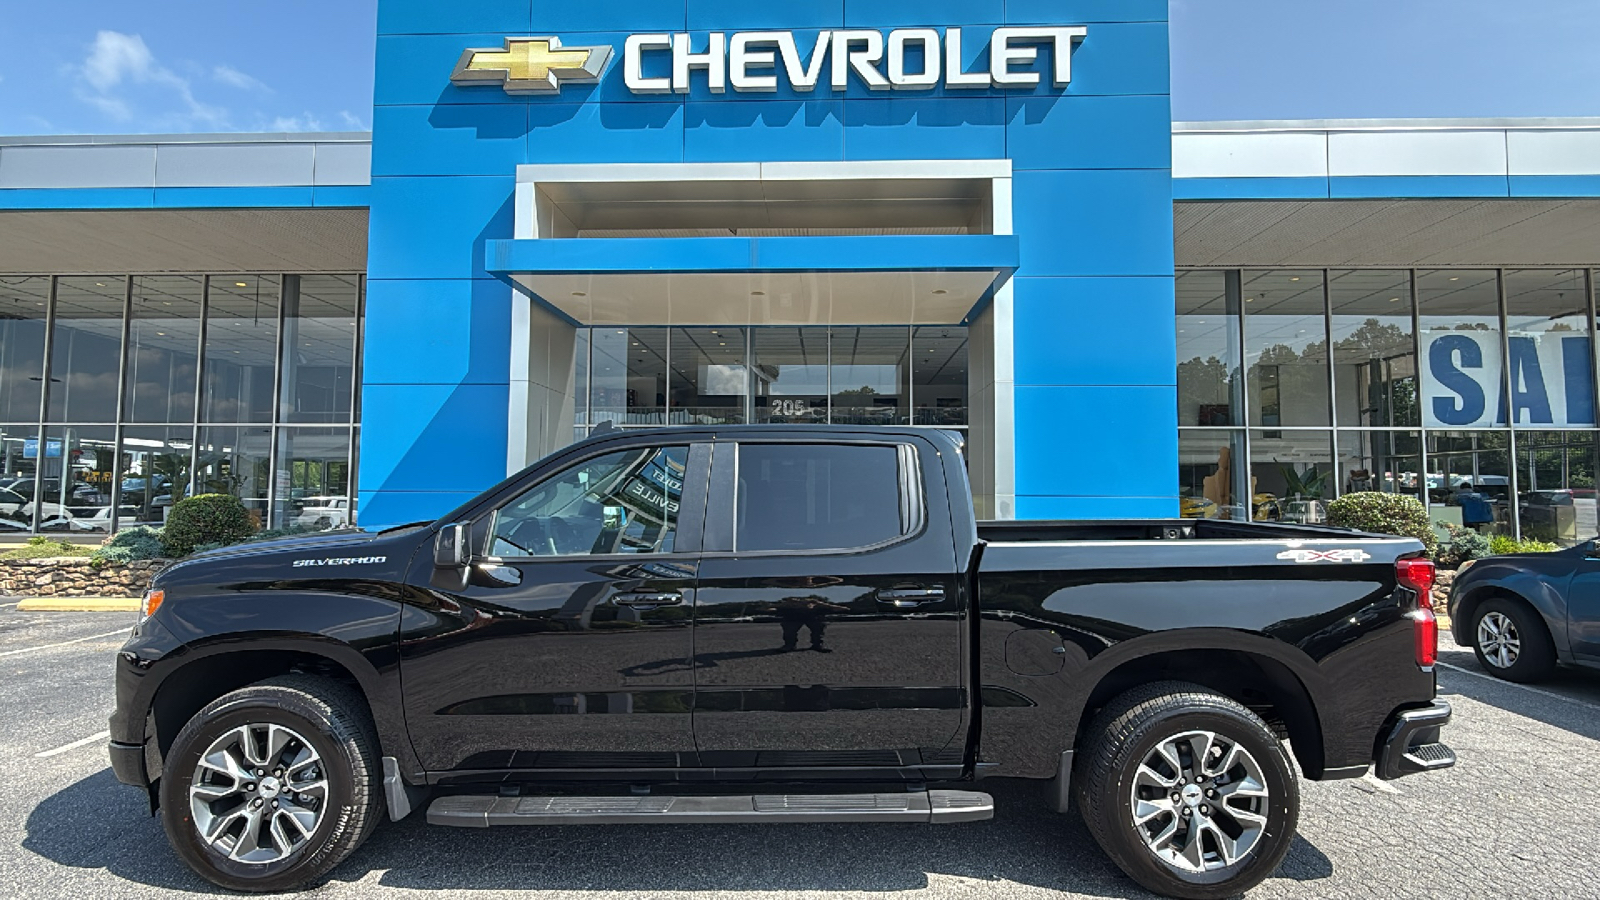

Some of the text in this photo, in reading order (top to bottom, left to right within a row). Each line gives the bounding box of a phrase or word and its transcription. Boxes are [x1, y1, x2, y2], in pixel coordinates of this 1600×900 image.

[624, 26, 1087, 95] CHEVROLET
[772, 399, 806, 416] 205
[292, 556, 387, 568] SILVERADO
